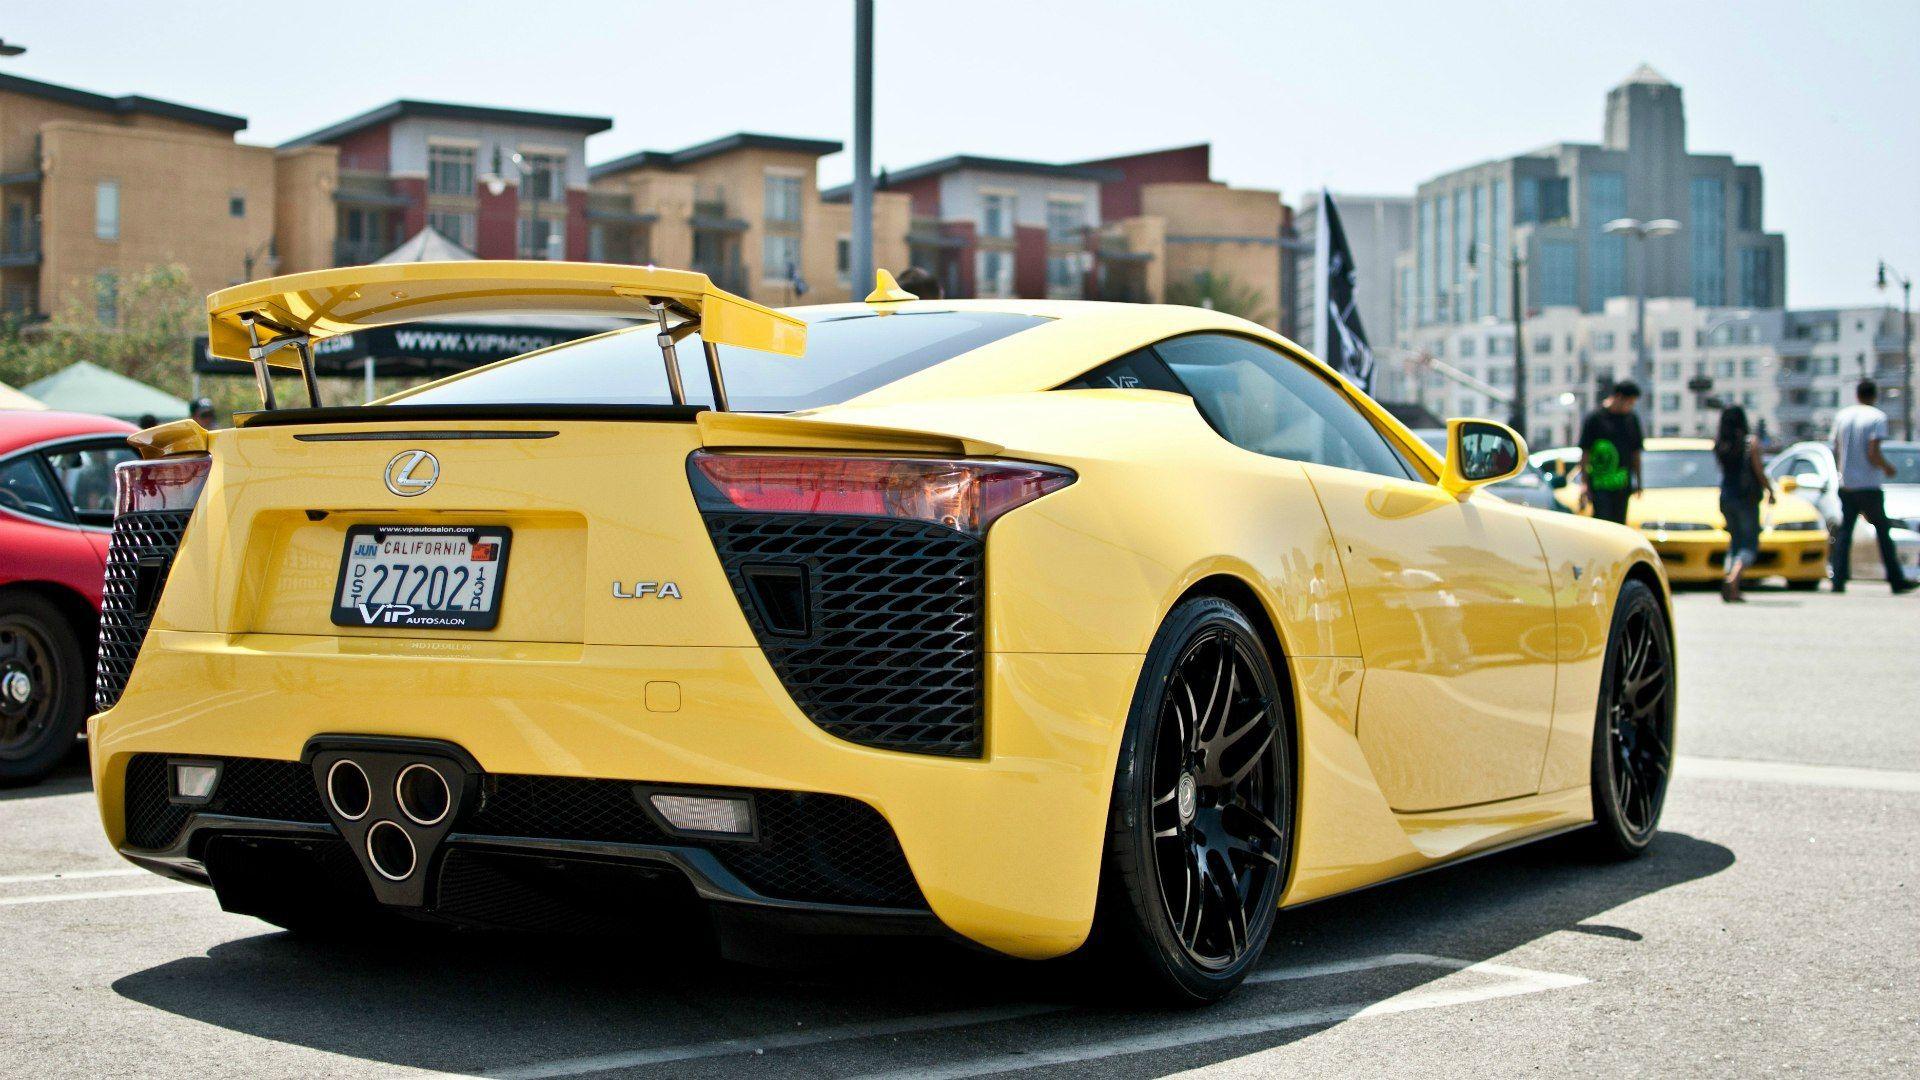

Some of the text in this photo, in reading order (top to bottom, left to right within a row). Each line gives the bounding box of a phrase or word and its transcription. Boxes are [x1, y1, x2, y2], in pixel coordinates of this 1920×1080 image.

[379, 526, 475, 534] www.vipautosalon.com
[354, 544, 378, 557] JUN
[384, 541, 467, 555] CALIFORNIA
[366, 564, 470, 611] 27202
[613, 581, 682, 599] LFA
[406, 617, 466, 626] AUTOSALON
